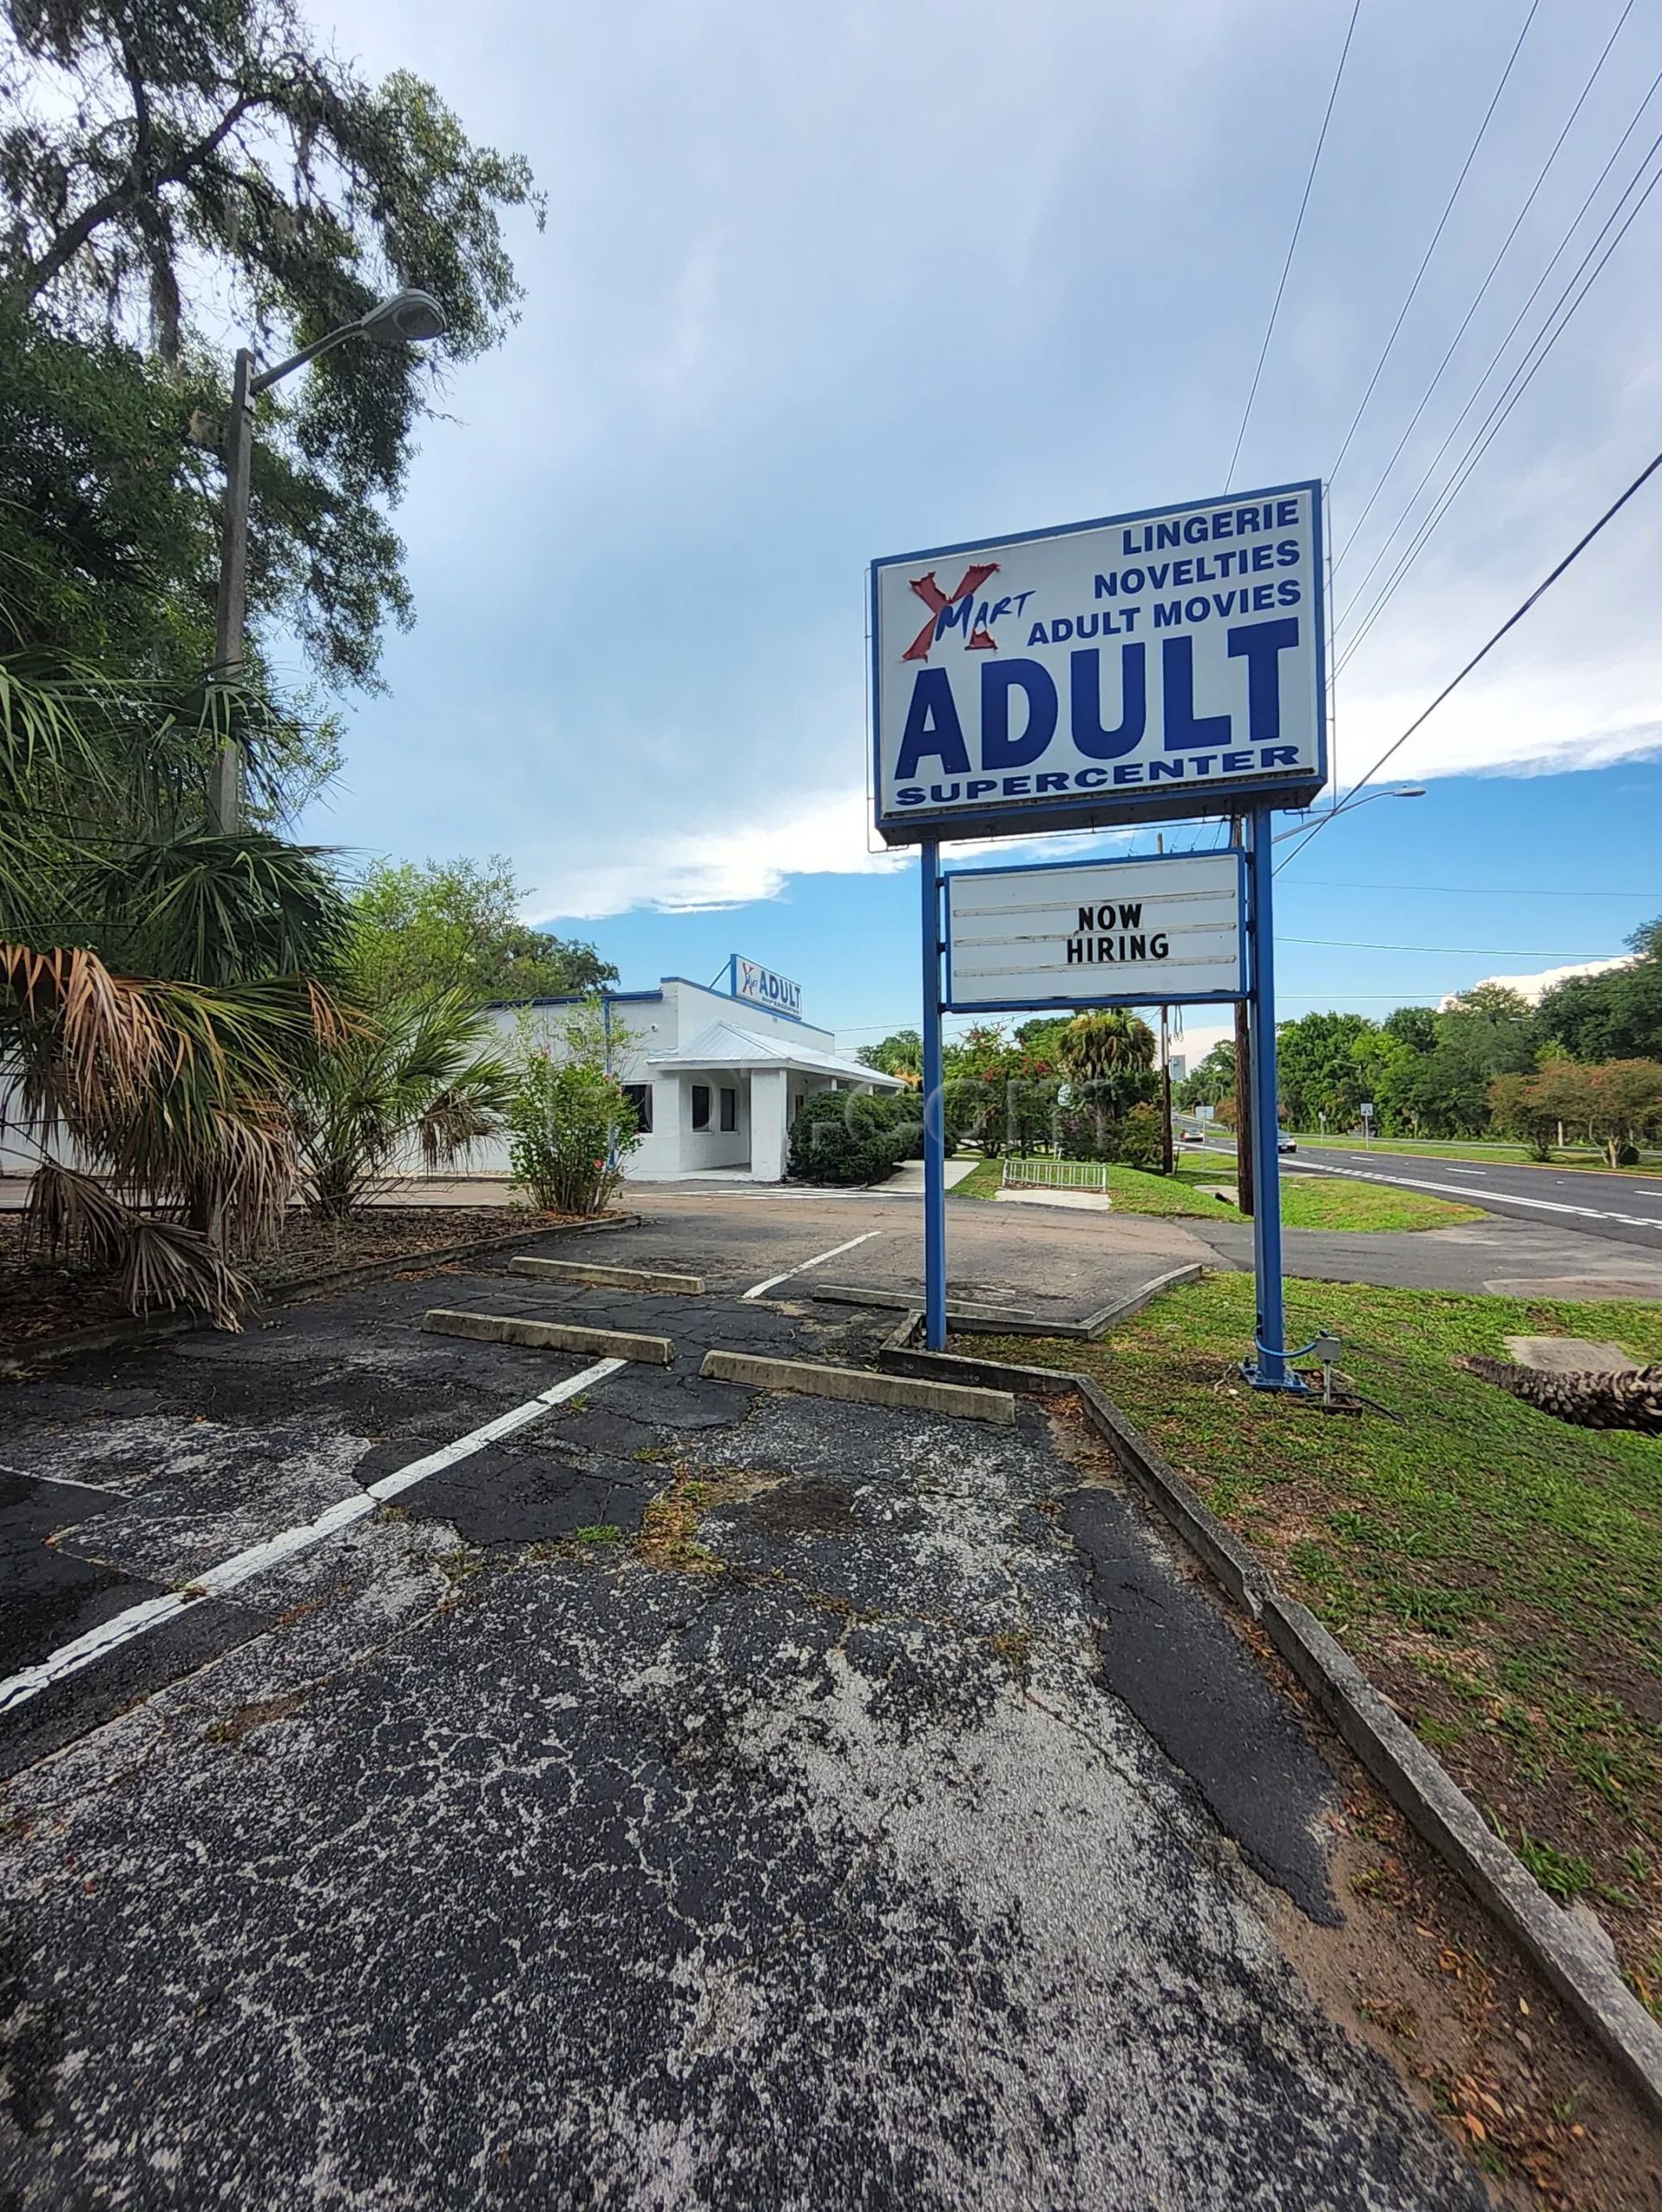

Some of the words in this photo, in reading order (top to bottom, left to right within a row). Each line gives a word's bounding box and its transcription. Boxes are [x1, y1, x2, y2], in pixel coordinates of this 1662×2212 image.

[1123, 499, 1300, 556] LINGERIE
[1094, 539, 1301, 600] NOVELTIES
[1027, 607, 1141, 646] ADULT
[1154, 579, 1302, 629] MOVIES
[894, 616, 1300, 780] ADULT
[895, 745, 1301, 807] SUPERCENTER
[1078, 903, 1143, 931] NOW
[1067, 932, 1169, 963] HIRING
[760, 969, 801, 1009] ADULT
[761, 996, 800, 1014] SUPERCENTER
